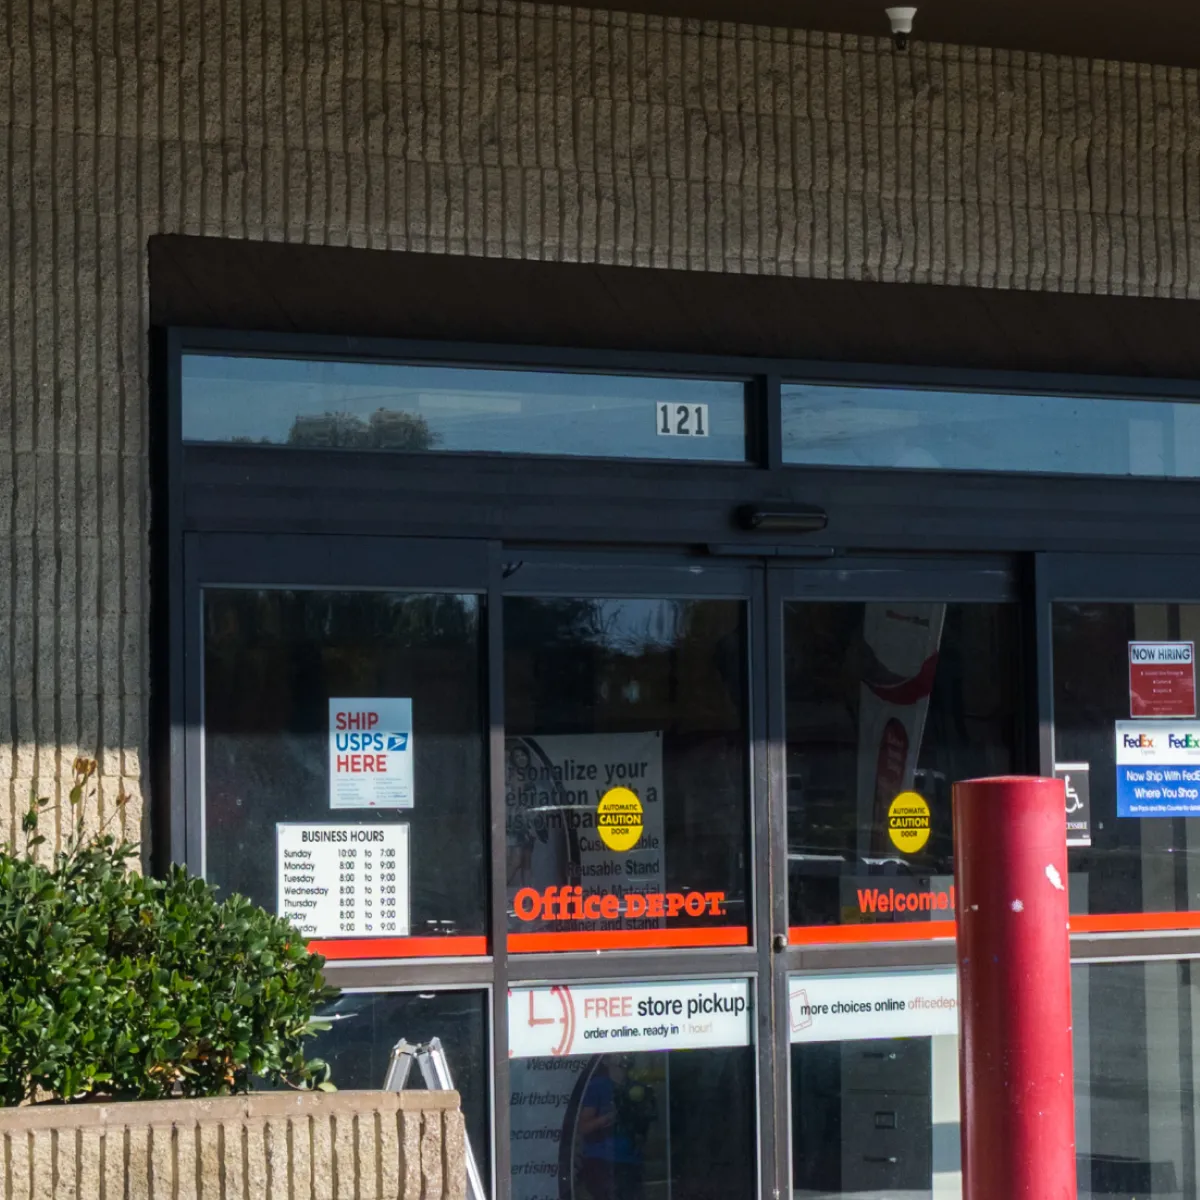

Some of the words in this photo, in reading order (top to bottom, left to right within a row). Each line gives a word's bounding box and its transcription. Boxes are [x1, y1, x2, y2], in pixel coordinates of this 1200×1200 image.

[660, 404, 705, 435] 121
[1132, 648, 1155, 660] NOW
[1158, 648, 1190, 660] HIRING
[335, 711, 379, 730] SHIP
[335, 732, 384, 751] USPS
[1123, 733, 1153, 748] FedEx
[1168, 733, 1200, 748] FedEx
[336, 754, 387, 773] HERE
[604, 761, 648, 783] your
[1126, 770, 1144, 781] Now
[1145, 770, 1162, 782] Ship
[1163, 770, 1181, 781] With
[646, 785, 658, 802] a
[1134, 787, 1161, 799] Where
[1161, 787, 1178, 798] You
[1178, 787, 1199, 800] Shop
[599, 814, 641, 825] CAUTION
[890, 817, 929, 828] CAUTION
[301, 830, 348, 842] BUSINESS
[350, 830, 385, 842] HOURS
[284, 849, 312, 859] Sunday
[338, 849, 357, 857] 10:00
[364, 849, 372, 857] to
[380, 848, 396, 857] 7:00
[284, 861, 315, 871] Monday
[339, 861, 355, 869] 8:00
[364, 861, 372, 869] to
[380, 860, 396, 869] 9:00
[624, 859, 660, 875] Stand
[284, 874, 315, 884] Tuesday
[339, 874, 355, 882] 8:00
[364, 874, 372, 882] to
[380, 873, 396, 882] 9:00
[284, 886, 329, 896] Wednesday
[339, 886, 355, 895] 8:00
[364, 886, 372, 895] to
[380, 885, 396, 895] 9:00
[284, 899, 317, 909] Thursday
[339, 899, 355, 907] 8:00
[364, 899, 372, 907] to
[380, 898, 396, 907] 9:00
[513, 885, 620, 921] Office
[284, 911, 307, 921] Friday
[339, 911, 355, 919] 8:00
[364, 911, 372, 919] to
[380, 910, 396, 919] 9:00
[339, 923, 355, 931] 9:00
[364, 923, 372, 931] to
[380, 922, 396, 931] 9:00
[584, 996, 633, 1018] FREE
[637, 995, 682, 1016] store
[801, 1004, 828, 1015] more
[832, 1000, 872, 1014] choices
[875, 998, 905, 1012] online
[584, 1027, 609, 1039] order
[611, 1025, 641, 1038] online.
[643, 1023, 669, 1038] ready
[670, 1022, 679, 1034] in
[682, 1023, 687, 1033] 1
[526, 1057, 588, 1071] Weddings
[510, 1091, 571, 1108] Birthdays
